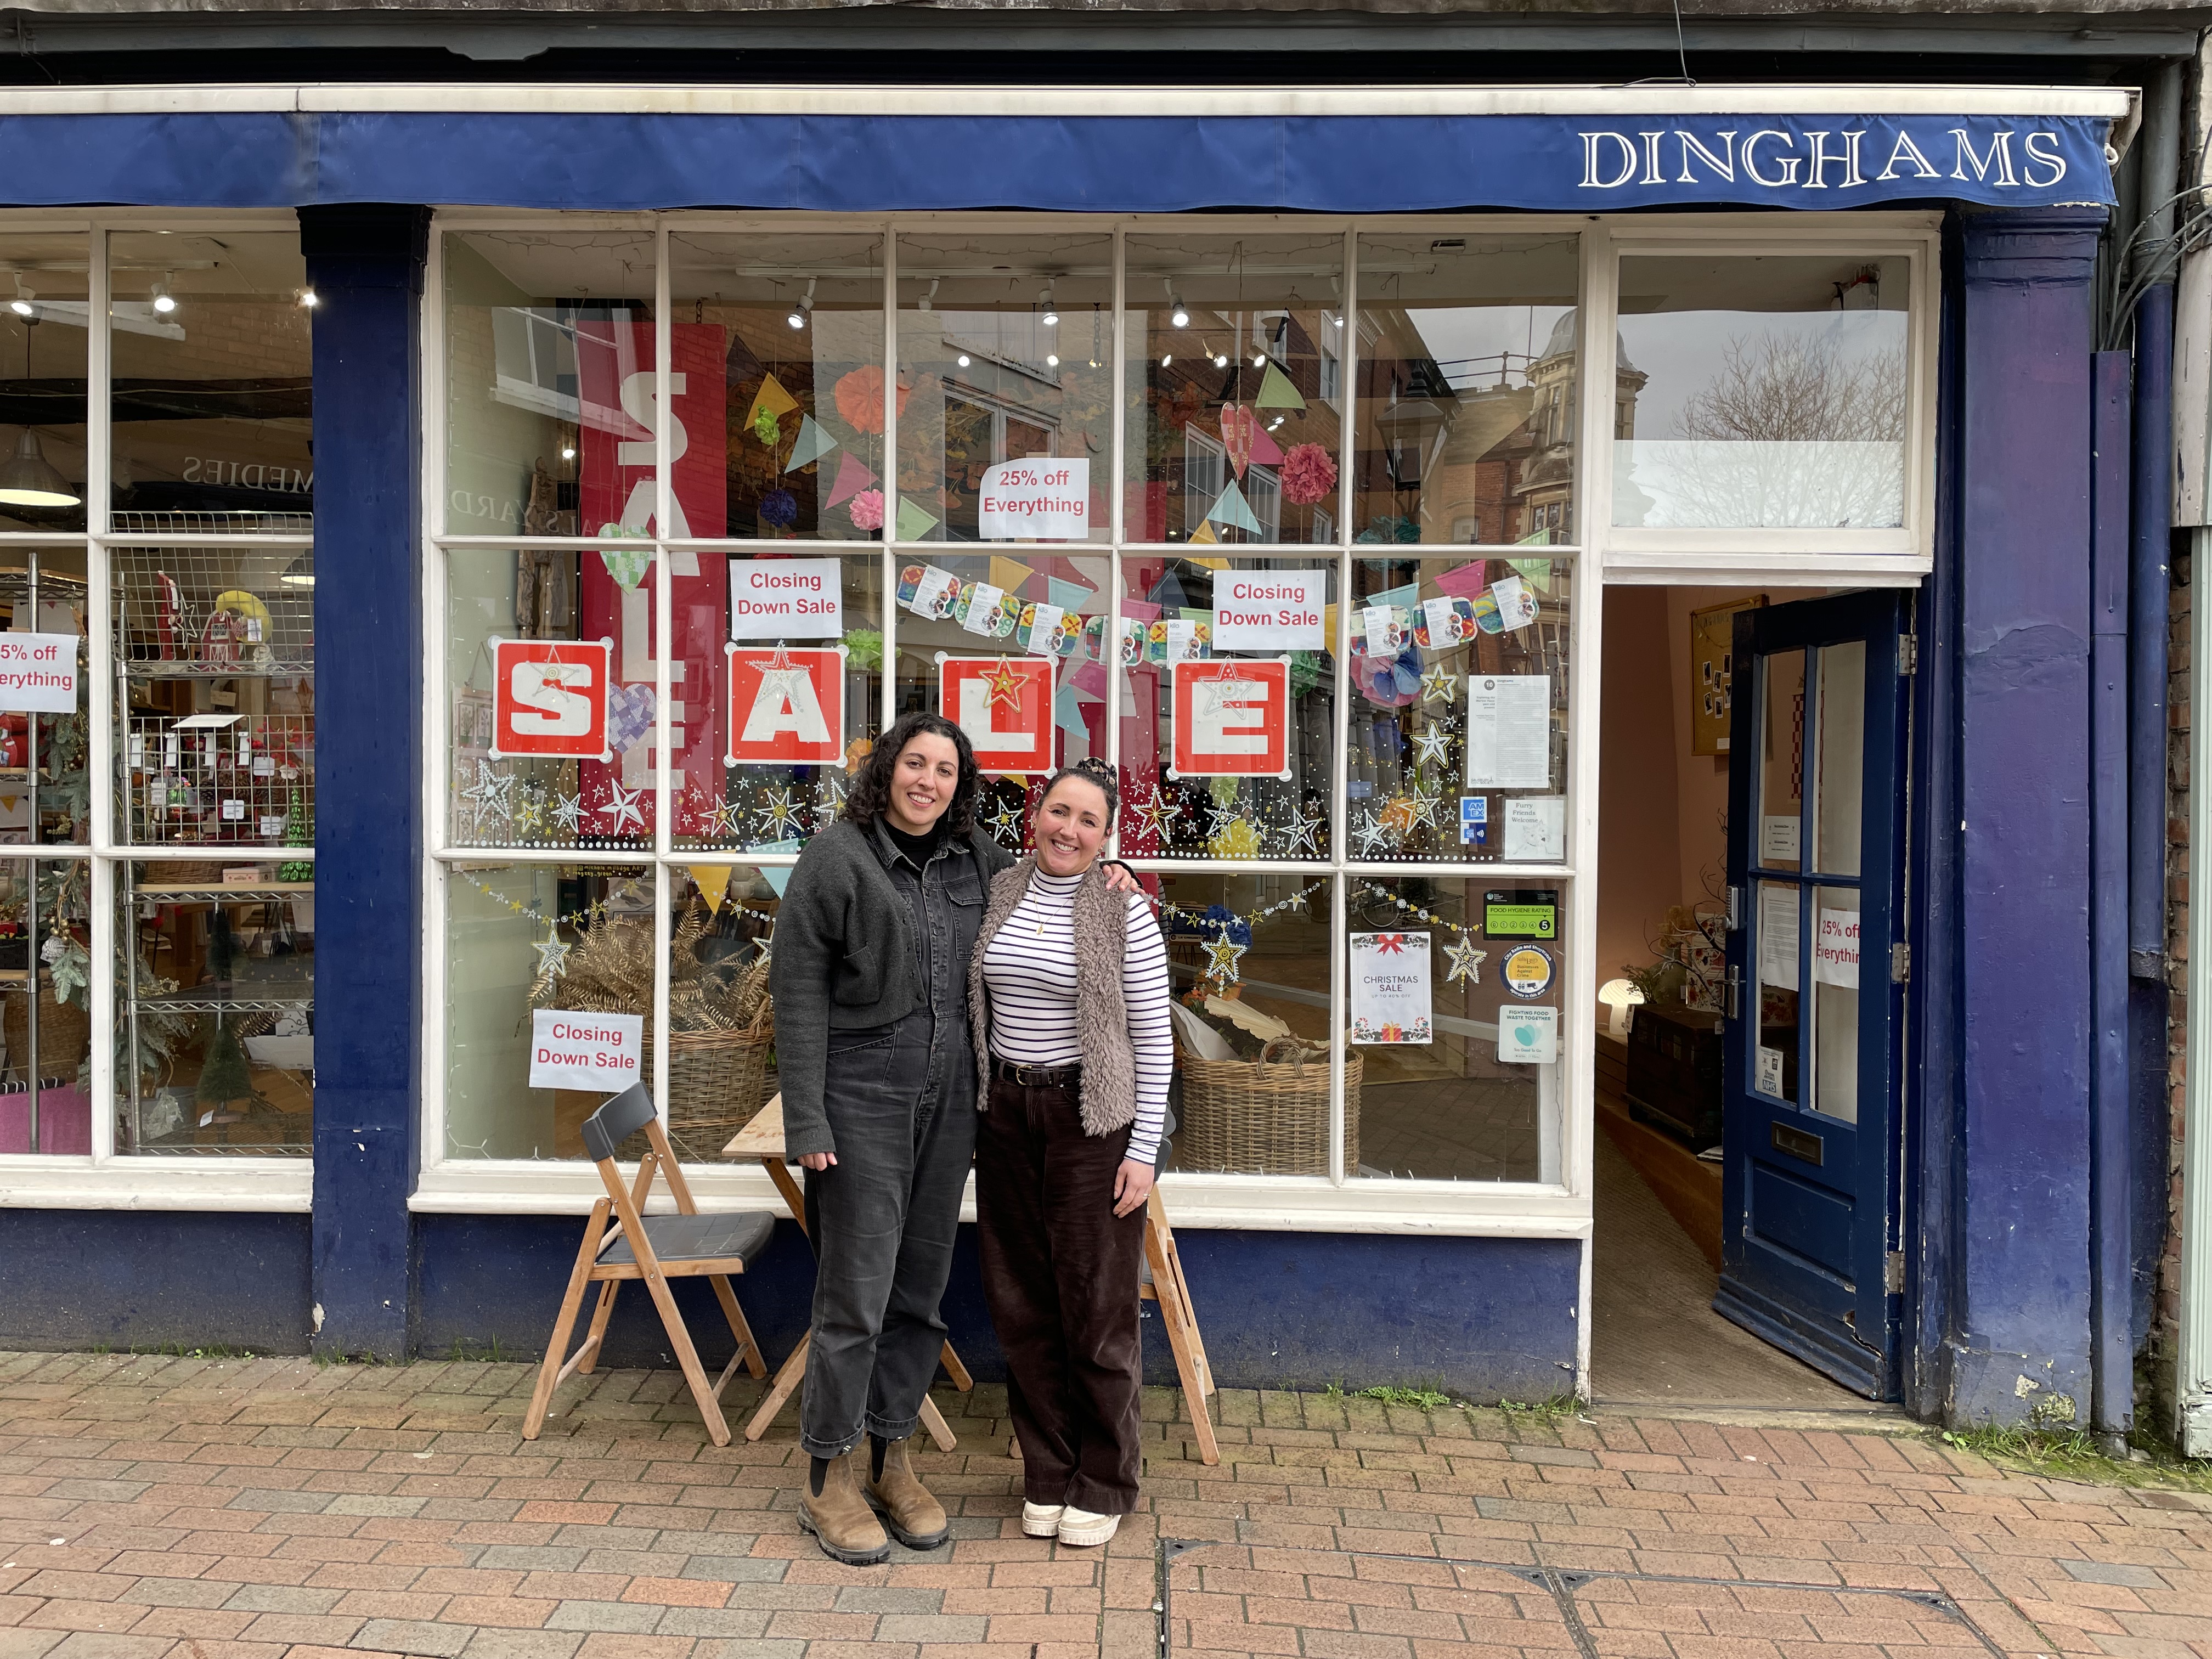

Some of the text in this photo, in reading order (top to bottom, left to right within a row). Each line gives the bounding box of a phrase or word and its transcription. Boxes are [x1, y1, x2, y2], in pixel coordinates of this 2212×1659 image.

[1578, 128, 2067, 190] DINGHAMS
[1000, 470, 1069, 486] 25% off
[984, 496, 1084, 516] Everything
[751, 573, 821, 591] Closing
[1233, 584, 1305, 603] Closing
[738, 599, 836, 614] Down Sale
[1220, 610, 1318, 626] Down Sale
[0, 644, 57, 661] 5% off
[0, 672, 72, 691] erything
[1541, 921, 1548, 930] 5
[1822, 919, 1842, 936] 25%
[1504, 952, 1513, 961] City
[1511, 945, 1523, 953] Radio
[1363, 975, 1419, 984] CHRISTMAS
[552, 1024, 622, 1046] Closing
[538, 1048, 635, 1068] Down Sale
[1763, 1080, 1776, 1092] NHS
